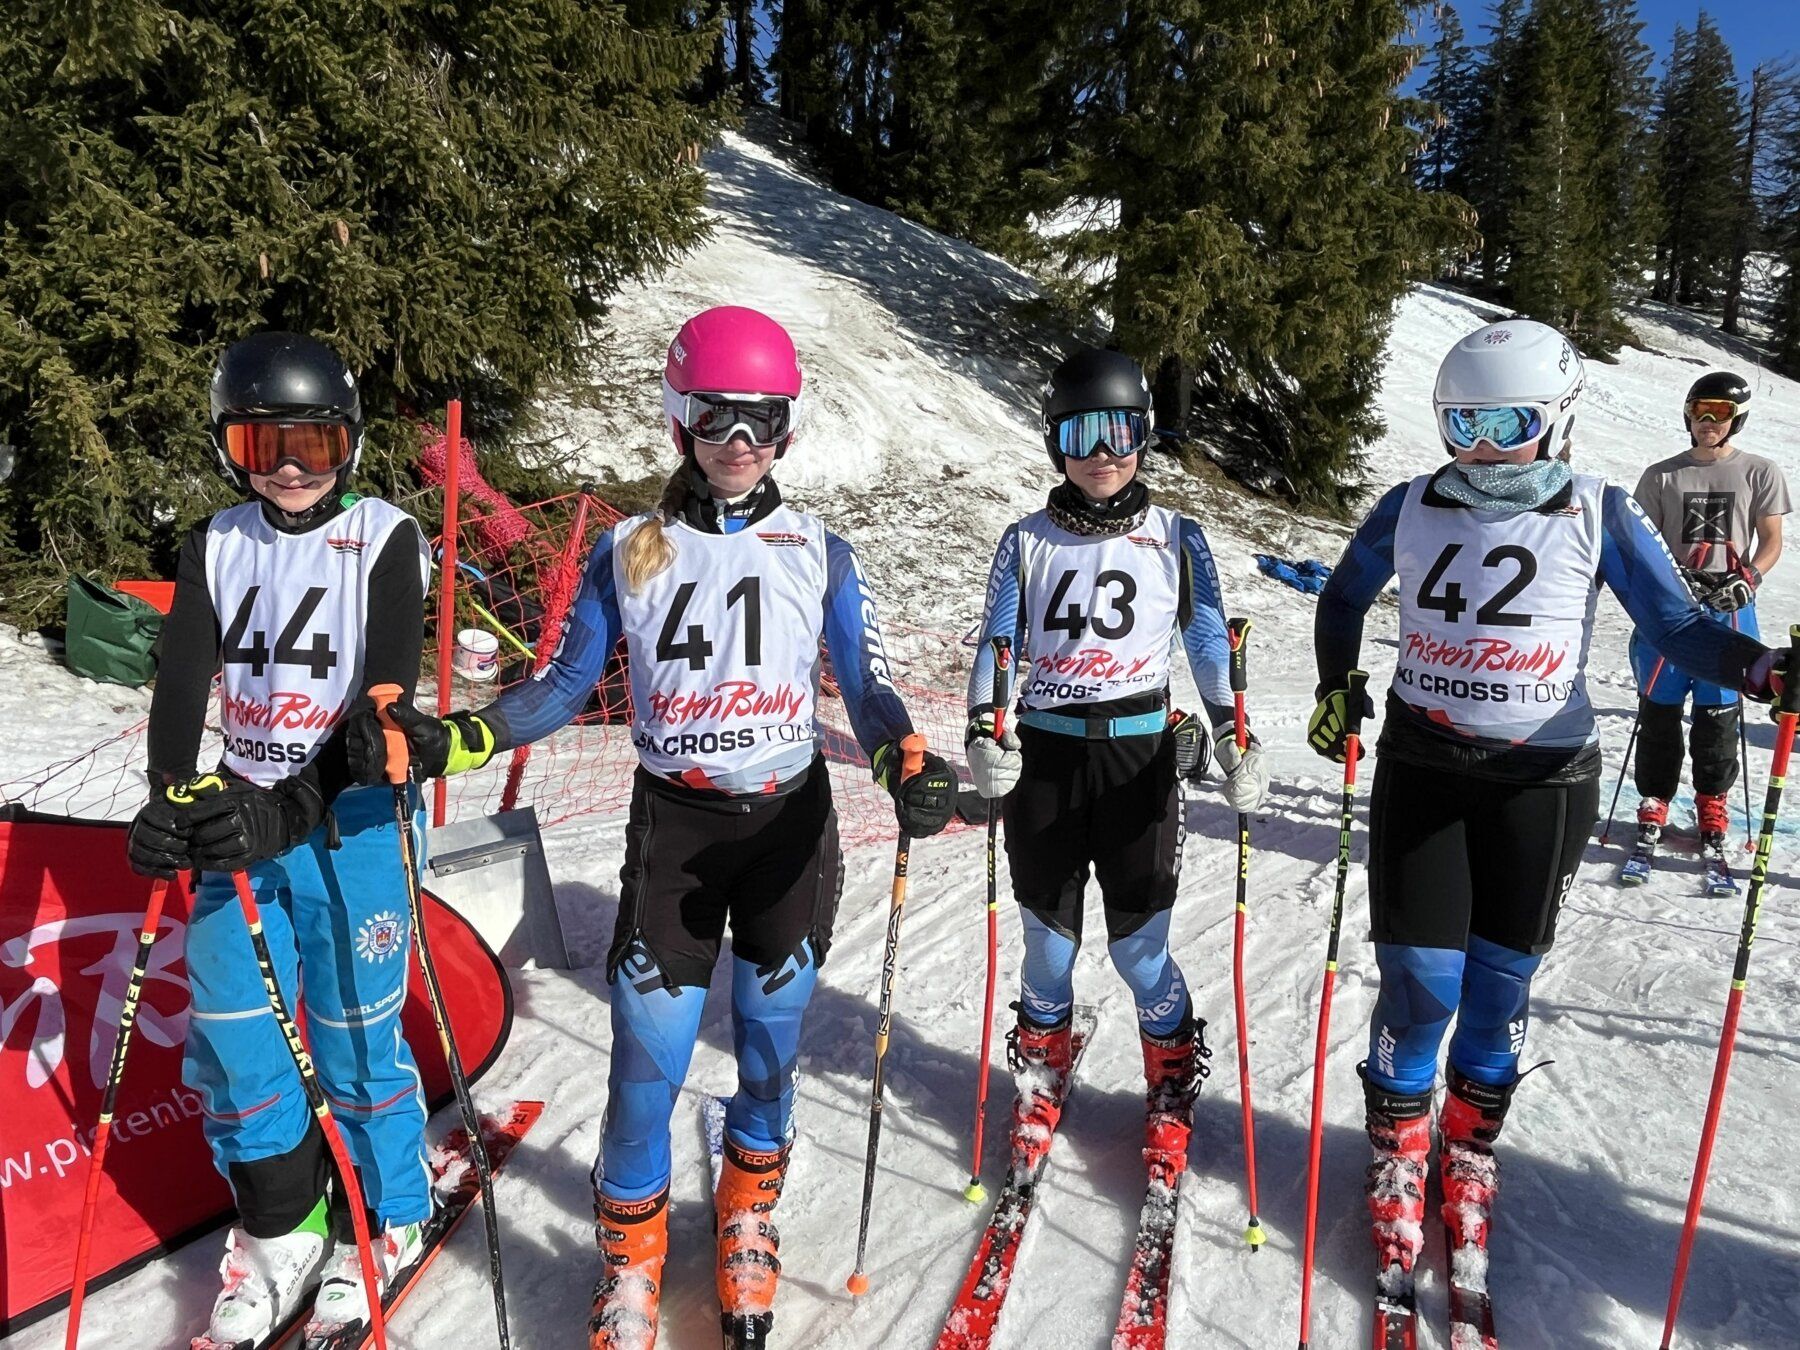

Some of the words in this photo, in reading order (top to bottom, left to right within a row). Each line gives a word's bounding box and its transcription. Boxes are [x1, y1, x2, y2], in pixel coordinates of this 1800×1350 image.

[1043, 569, 1137, 640] 43
[1417, 543, 1537, 627] 42
[223, 585, 338, 680] 44
[656, 576, 762, 672] 41
[1420, 673, 1508, 703] CROSS
[1516, 680, 1580, 704] TOUR
[236, 738, 307, 763] CROSS
[663, 729, 755, 755] CROSS
[1241, 830, 1249, 879] LEKI
[878, 904, 902, 1036] KERMA
[283, 1022, 314, 1077] LEKI
